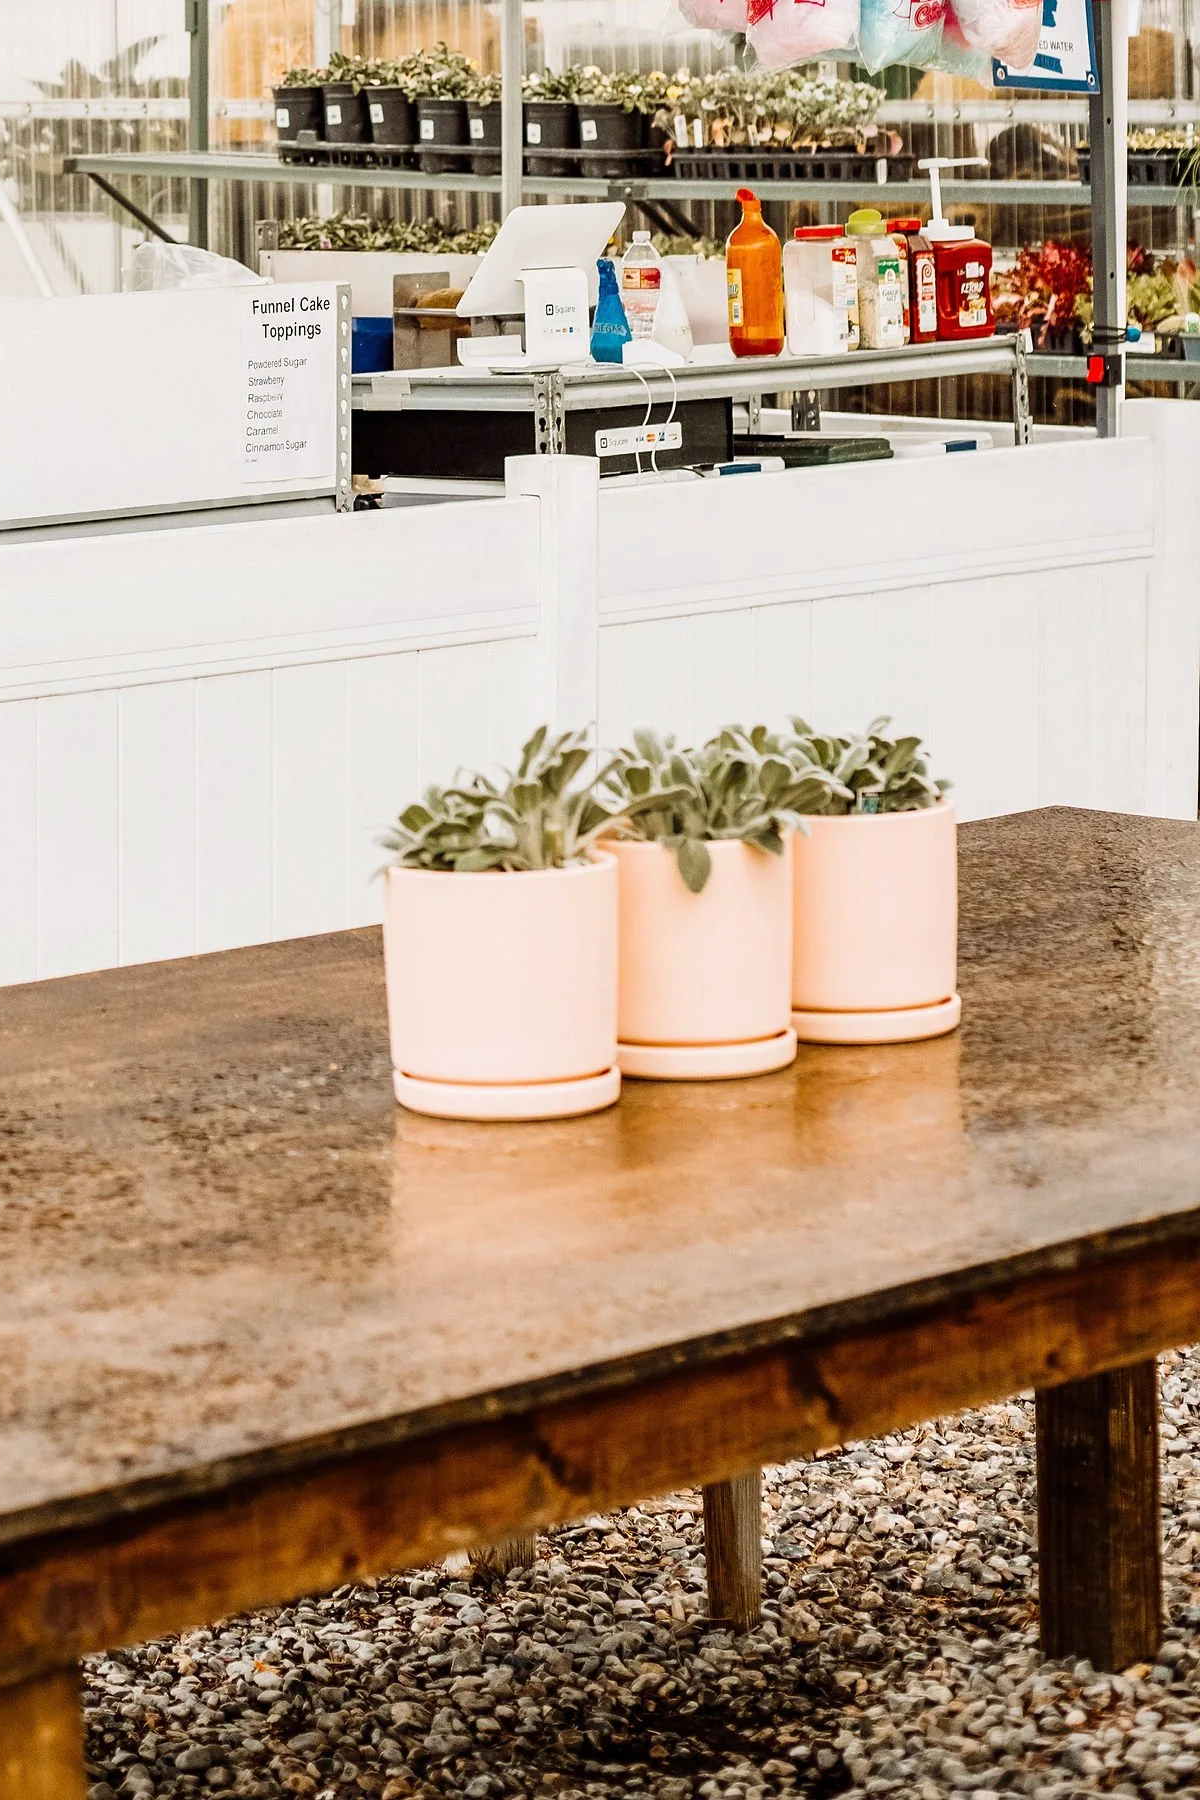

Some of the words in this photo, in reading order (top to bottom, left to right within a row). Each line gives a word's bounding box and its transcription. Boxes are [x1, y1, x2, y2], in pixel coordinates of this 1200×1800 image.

[1050, 41, 1074, 52] WATER
[252, 298, 295, 315] Funnel
[299, 296, 331, 312] Cake
[554, 304, 576, 314] Square
[262, 321, 322, 342] Toppings
[248, 358, 282, 370] Powdered
[284, 356, 308, 369] Sugar
[248, 375, 284, 387] Strawberry
[248, 392, 284, 404] Raspberry
[246, 408, 283, 420] Chocolate
[246, 426, 279, 436] Caramel
[246, 442, 284, 454] Cinnamon
[286, 440, 308, 451] Sugar
